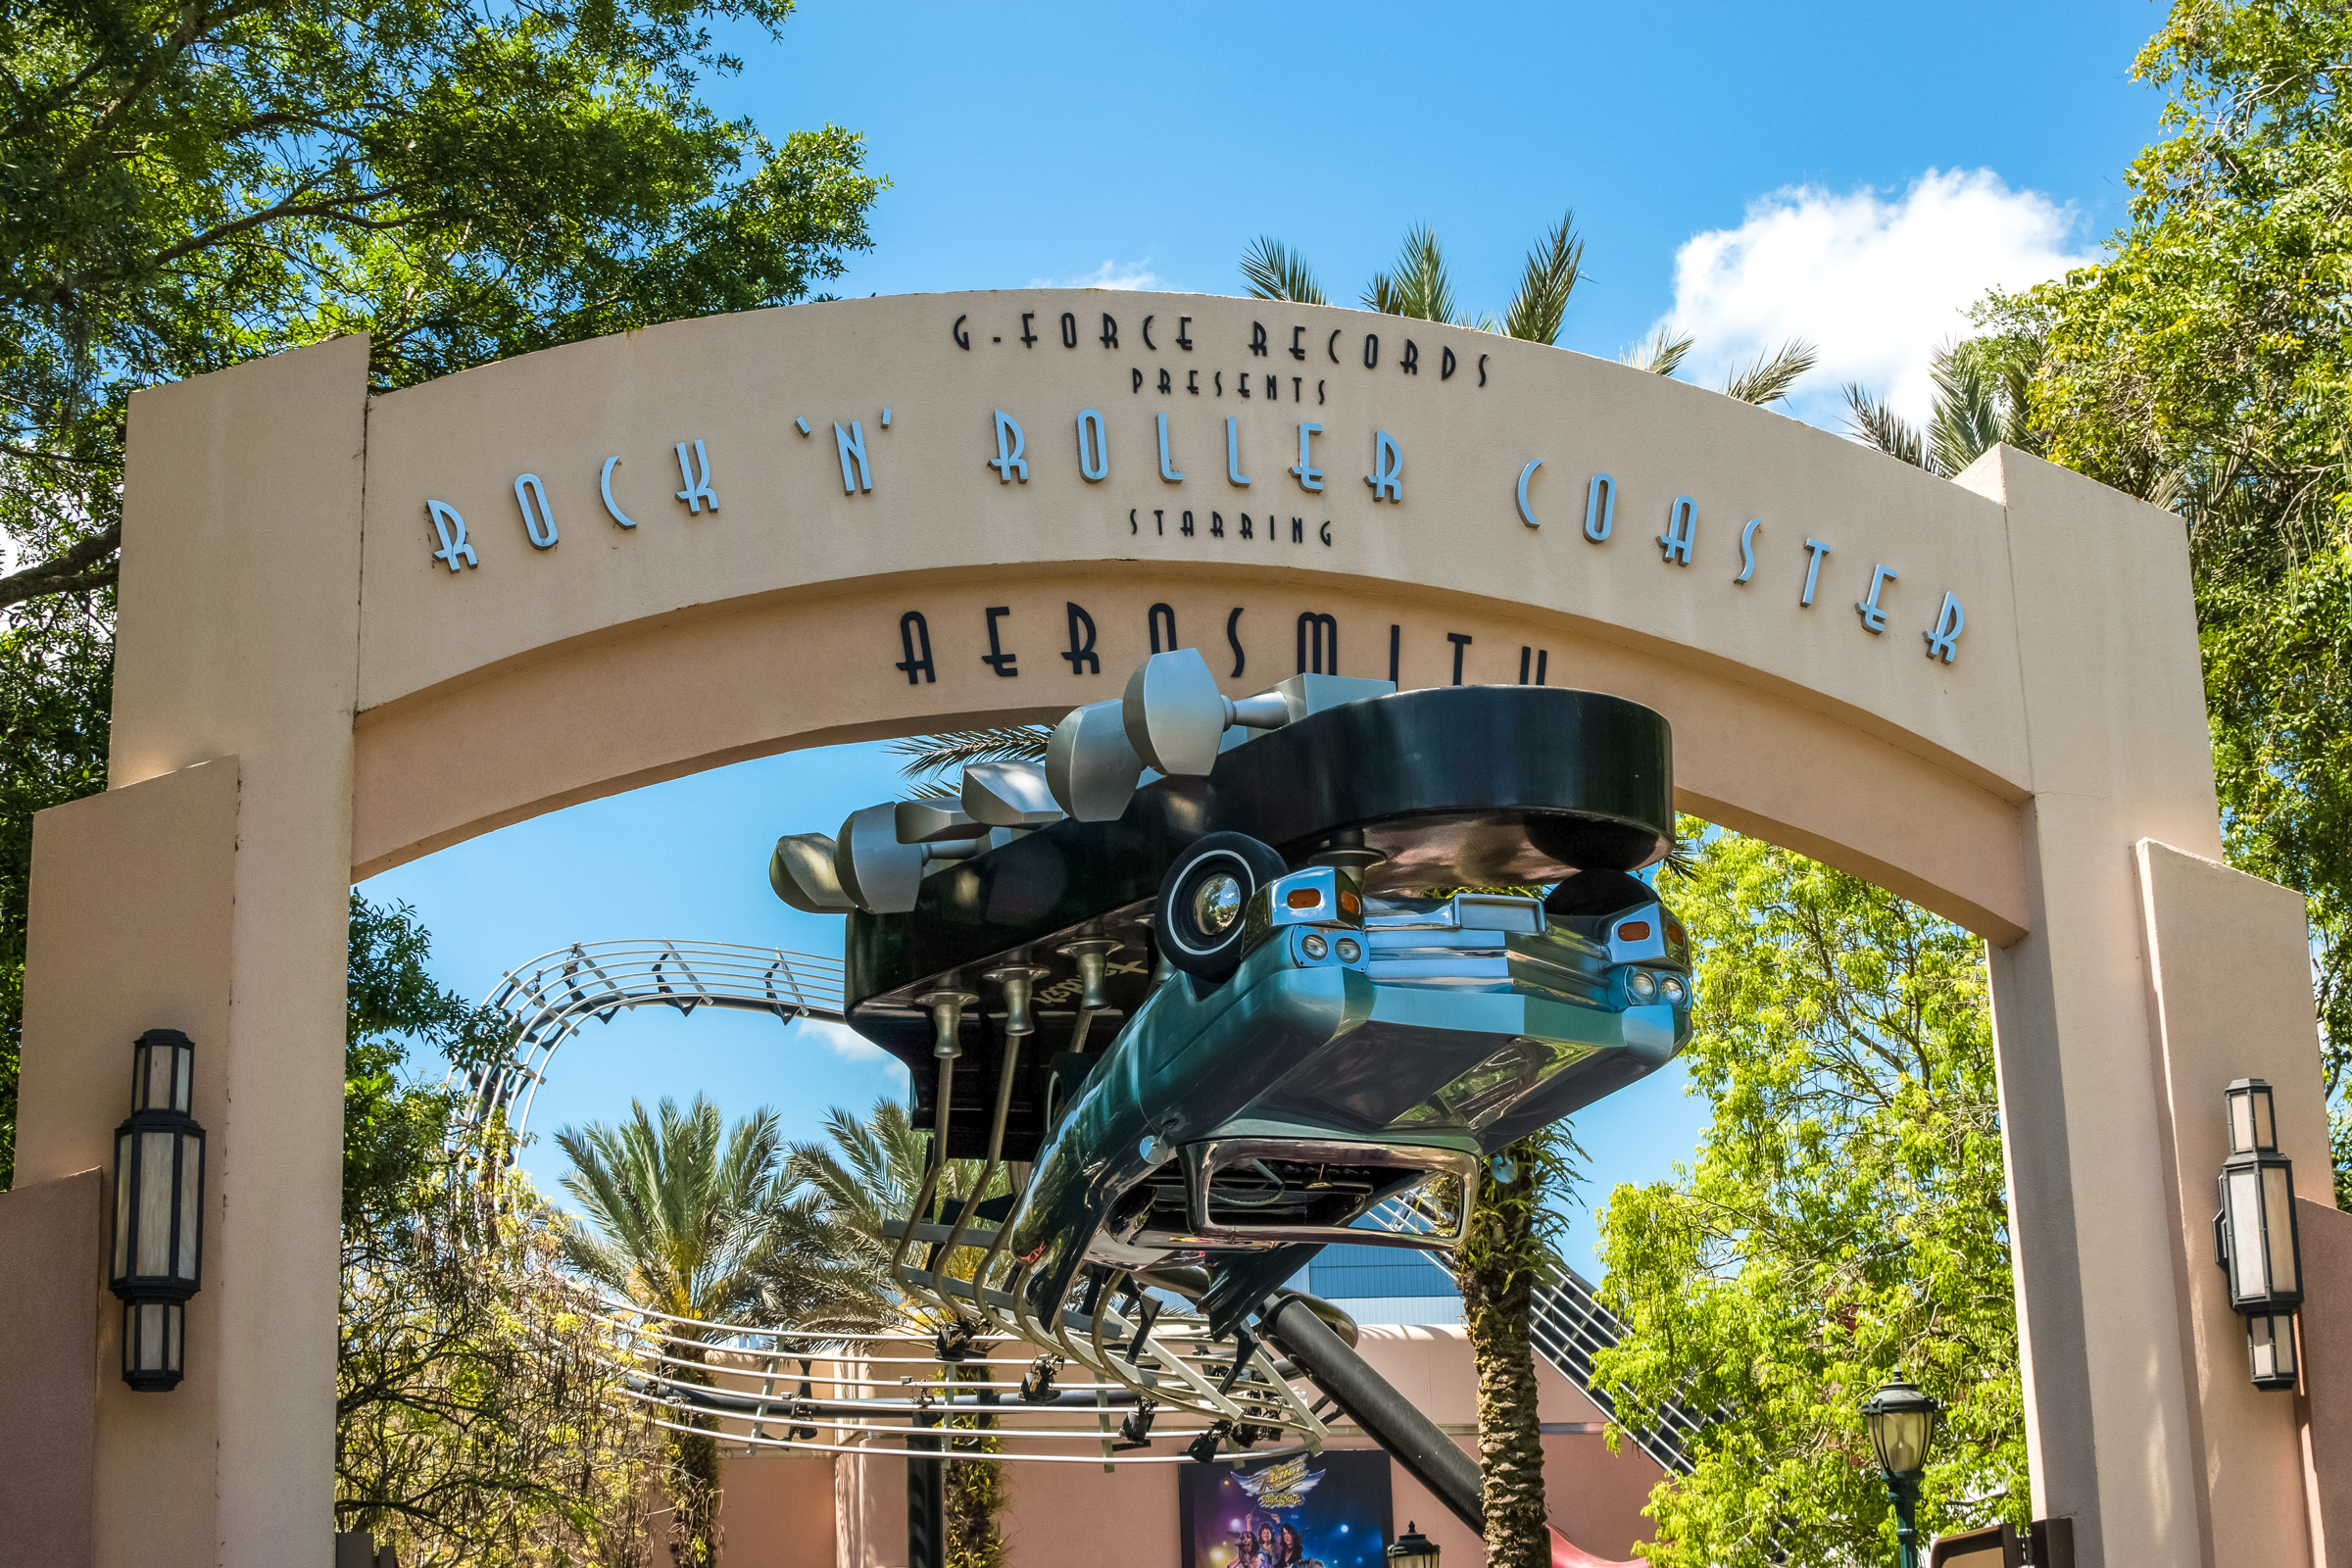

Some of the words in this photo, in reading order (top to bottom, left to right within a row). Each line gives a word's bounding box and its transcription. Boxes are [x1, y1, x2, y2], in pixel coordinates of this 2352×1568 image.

[953, 312, 1194, 352] G-FORCE
[1248, 320, 1489, 388] RECORDS
[1132, 367, 1326, 406] PRESENTS
[425, 438, 719, 573] ROCK
[988, 408, 1403, 504] ROLLER
[1514, 458, 1966, 665] COASTER
[1129, 508, 1332, 547] STARRING
